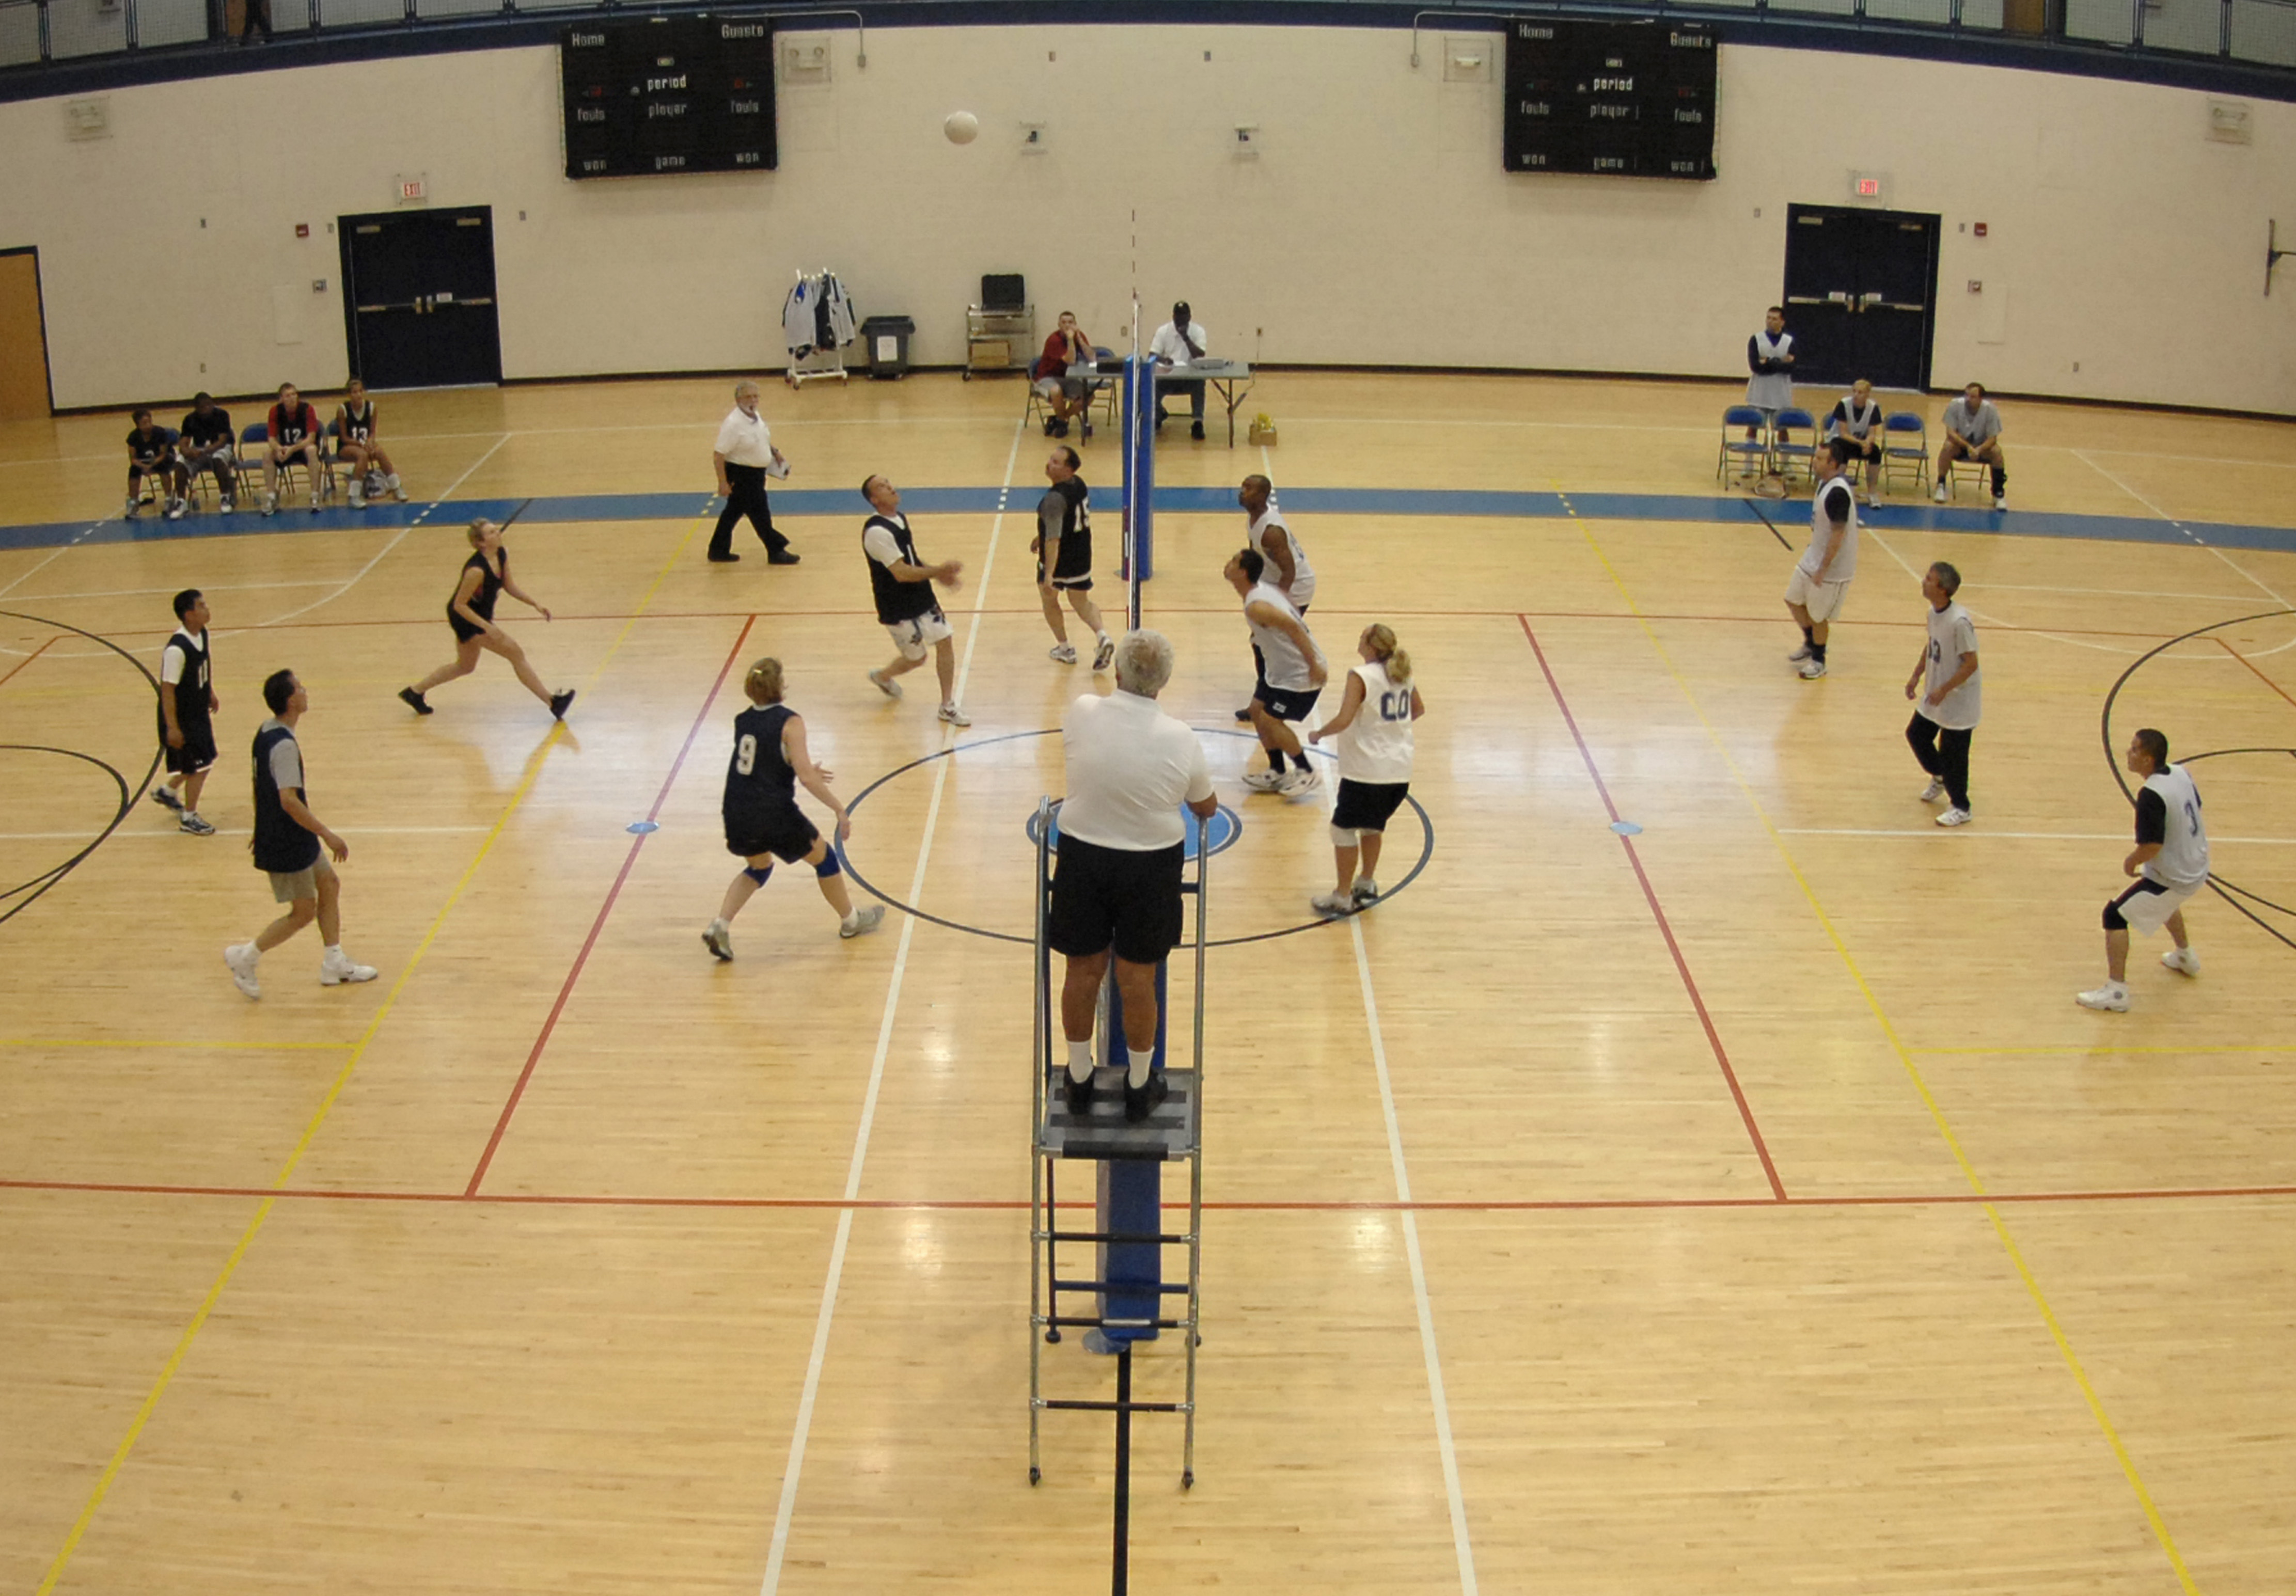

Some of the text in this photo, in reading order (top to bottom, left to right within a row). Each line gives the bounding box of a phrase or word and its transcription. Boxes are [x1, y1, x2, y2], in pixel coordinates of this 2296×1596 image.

[1519, 25, 1553, 39] Home
[572, 34, 605, 46] Home
[648, 74, 686, 91] period
[1594, 77, 1632, 91] period
[577, 108, 605, 120] fouls
[649, 102, 687, 118] player
[1591, 103, 1629, 119] player
[655, 155, 685, 168] game
[1594, 157, 1623, 170] game
[736, 734, 757, 775] 9
